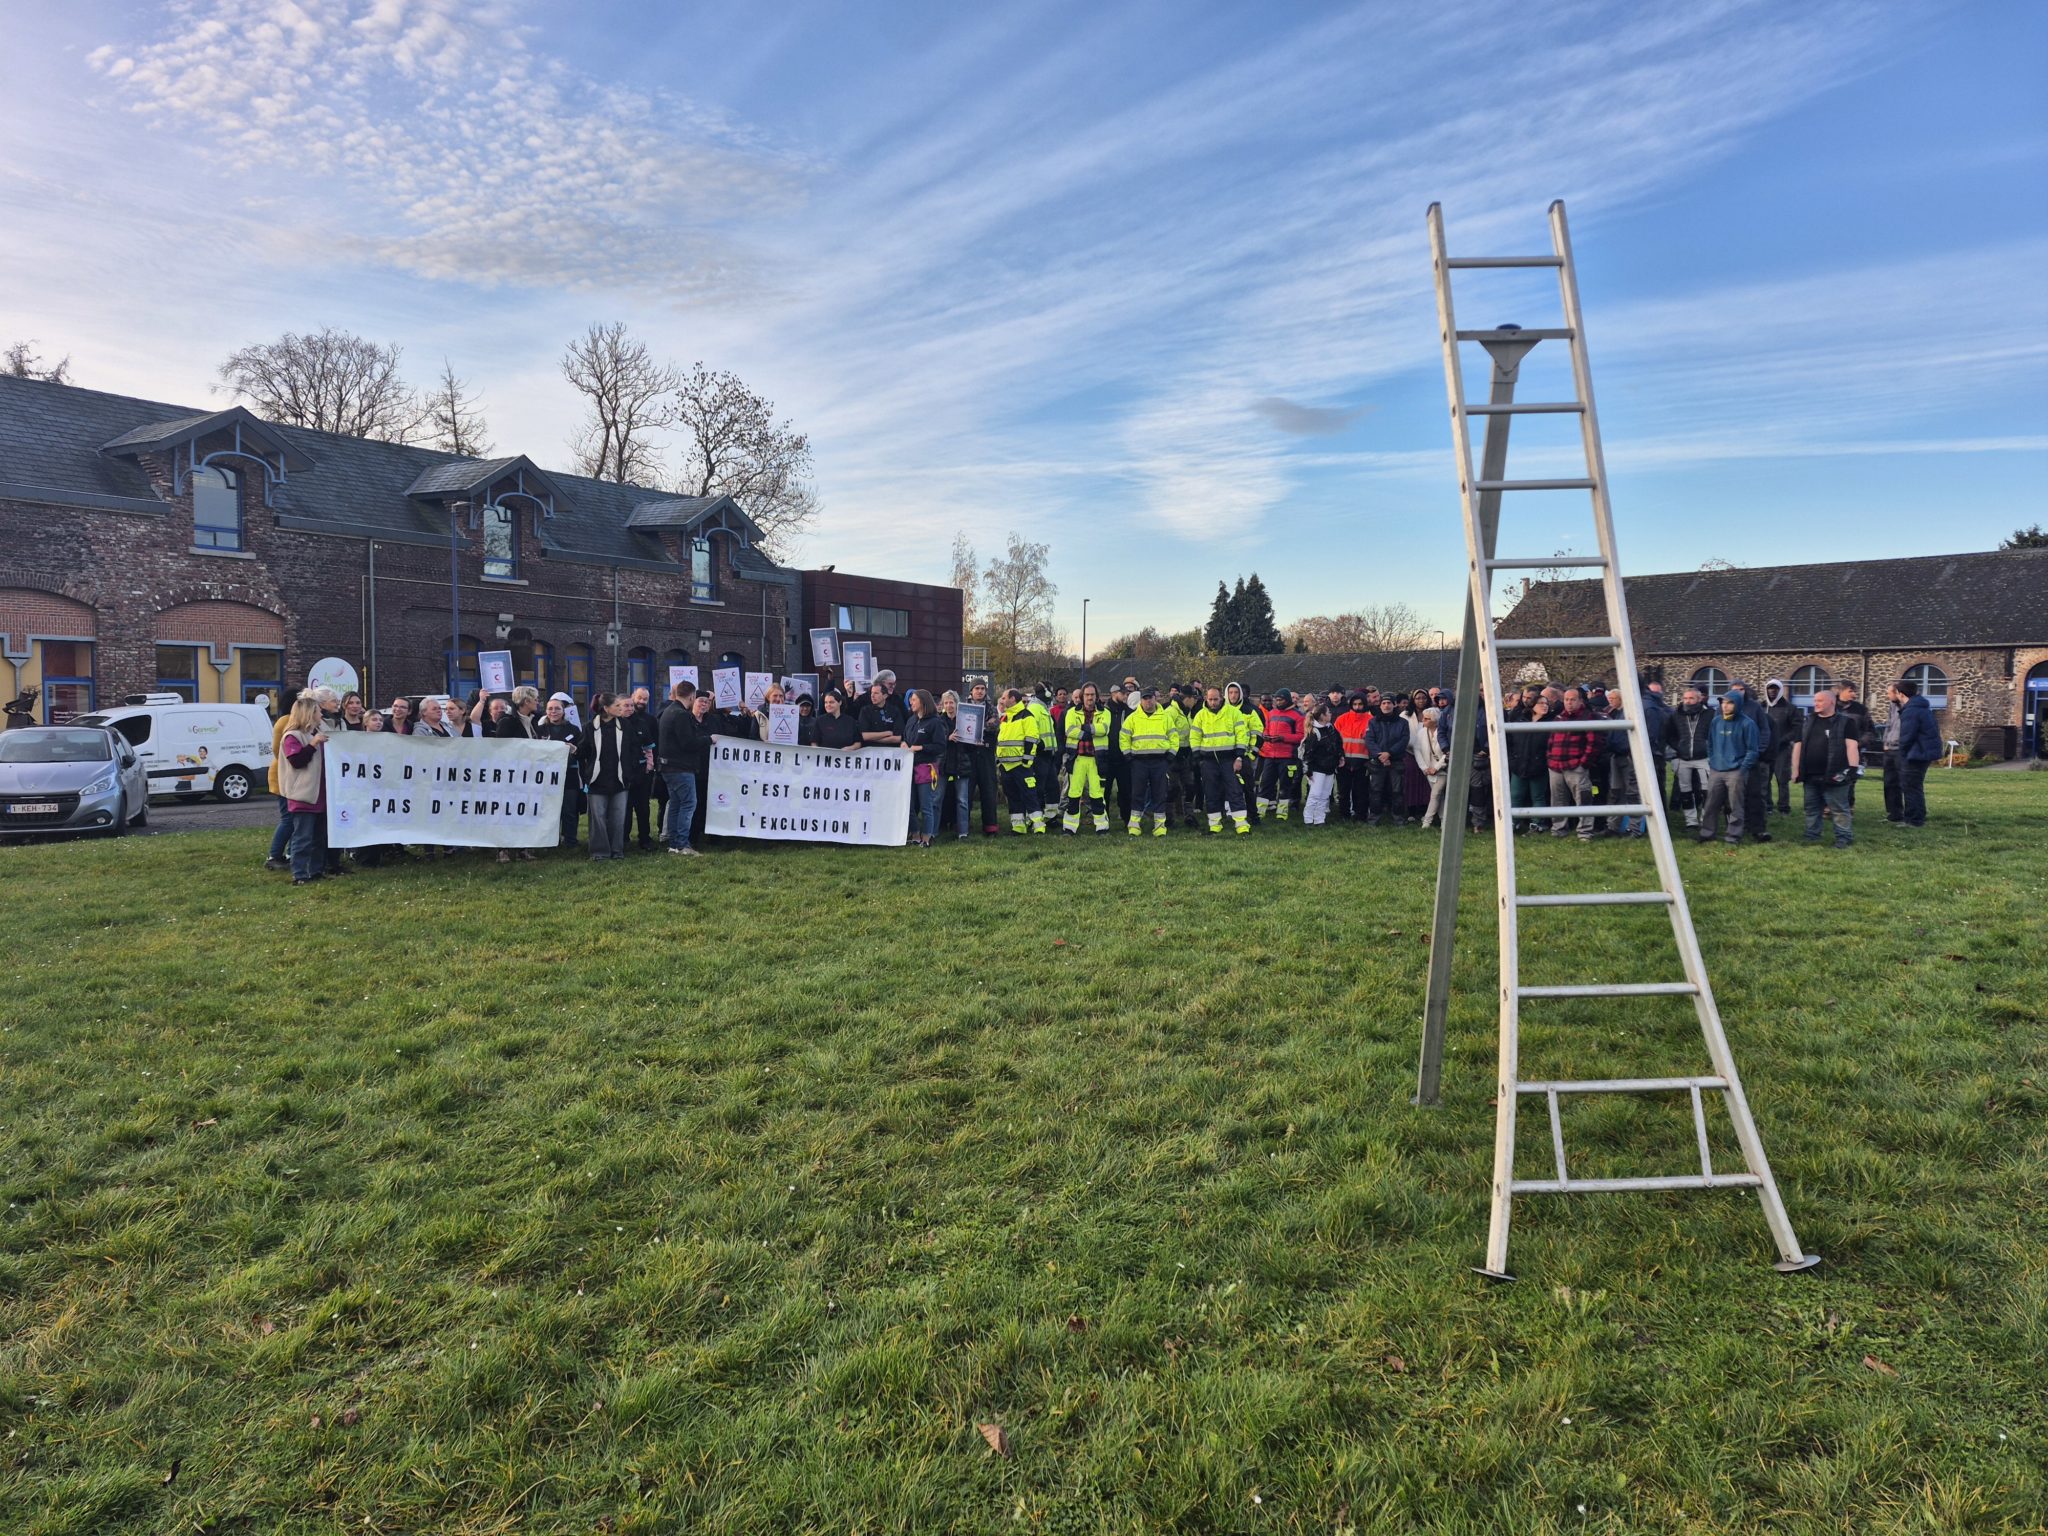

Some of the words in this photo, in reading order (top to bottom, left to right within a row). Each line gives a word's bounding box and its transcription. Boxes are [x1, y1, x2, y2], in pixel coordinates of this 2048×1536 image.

[714, 747, 782, 764] IGNORER
[794, 753, 902, 772] L'INSERTION
[342, 763, 382, 779] PAS
[404, 765, 559, 786] D'INSERTION
[741, 779, 790, 798] C'EST
[803, 786, 872, 802] CHOISIR
[372, 798, 411, 814] PAS
[432, 799, 539, 816] D'EMPLOI
[739, 812, 850, 834] L'EXCLUSION
